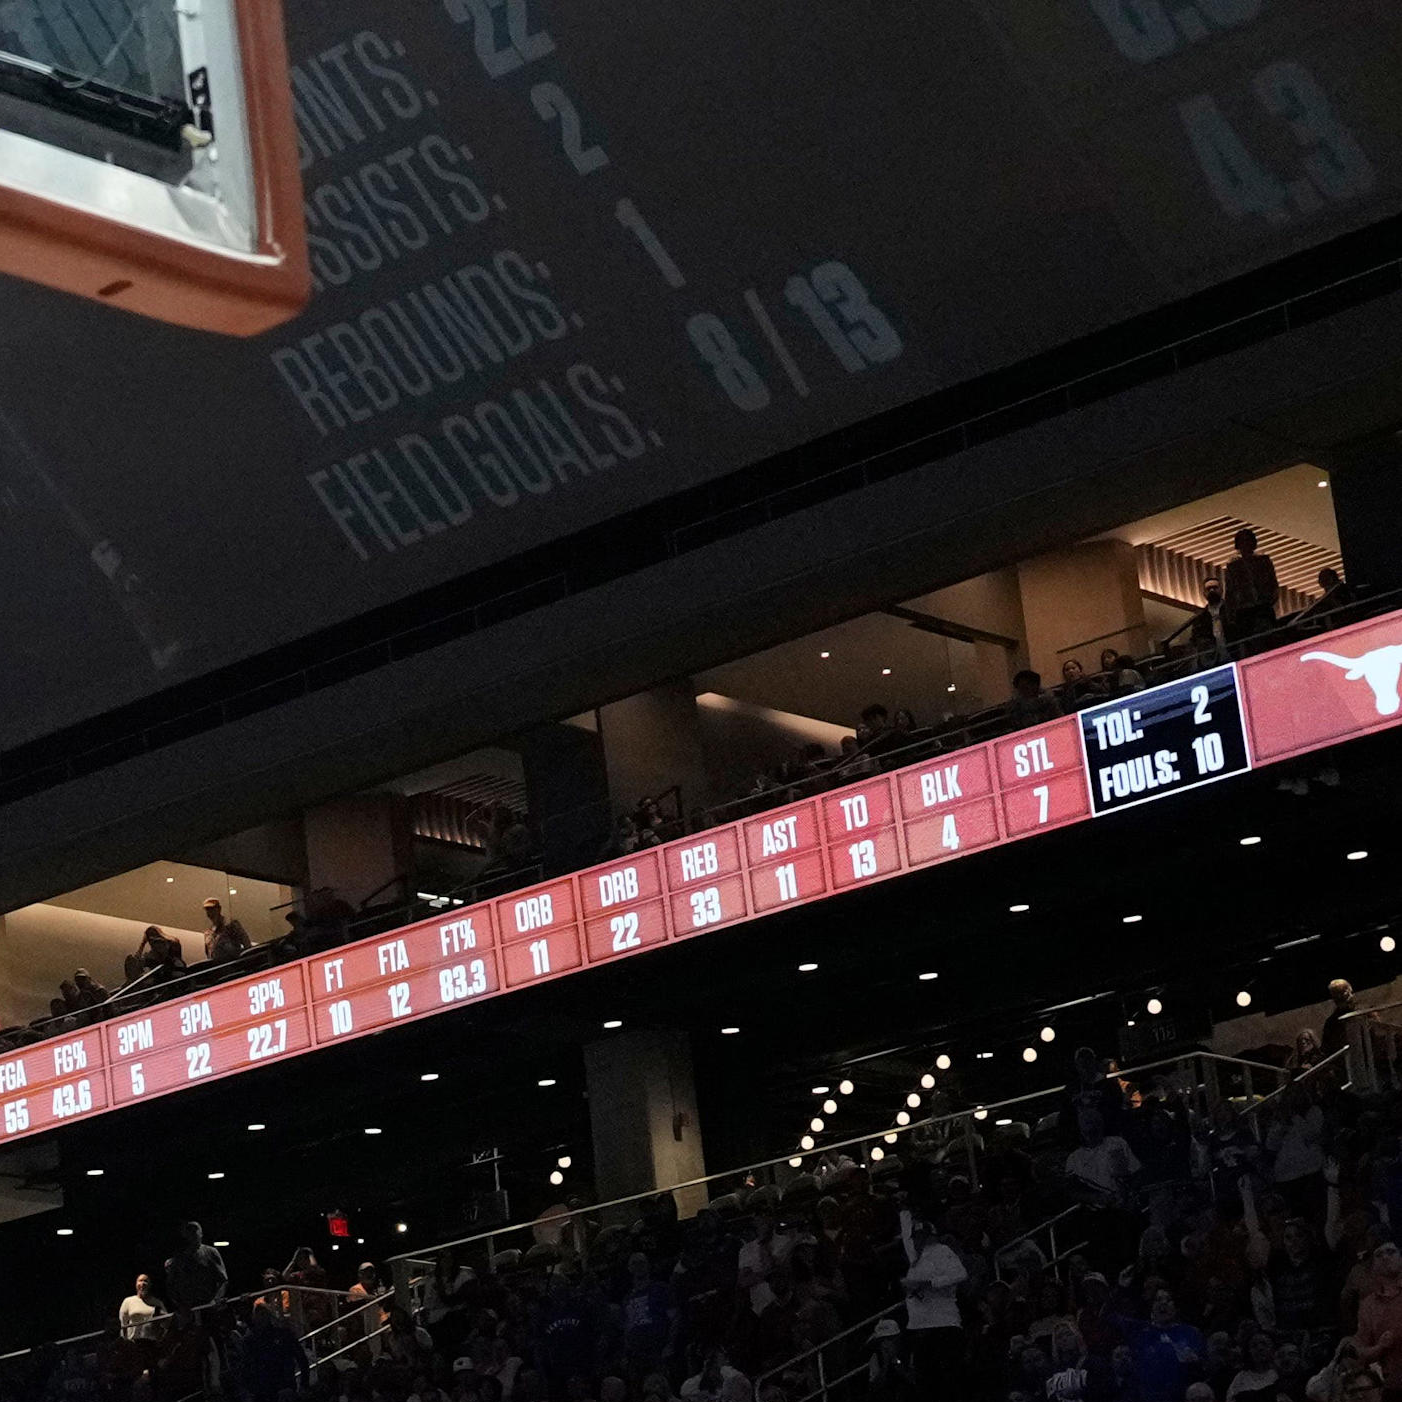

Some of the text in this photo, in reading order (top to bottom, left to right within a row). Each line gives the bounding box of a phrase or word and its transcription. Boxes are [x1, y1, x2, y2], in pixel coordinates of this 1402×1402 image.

[290, 31, 439, 170] INTS:
[309, 82, 609, 293] SSISTS: 2
[271, 198, 686, 436] REBOUNDS: 1
[307, 434, 472, 562] FIELD
[442, 364, 665, 508] GOALS:
[1092, 686, 1212, 751] TOL: 2
[1099, 733, 1224, 802] FOULS: 10
[516, 738, 1053, 932] ORB DRB REB AST TO BLK STL
[530, 786, 1049, 975] 11 22 33 11 13 4 7
[325, 919, 475, 991] FT FTA FT%
[118, 979, 284, 1055] 3PM 3PA 3P%
[330, 961, 486, 1035] 10 12 83.3
[54, 1041, 86, 1076] FG%
[130, 1019, 288, 1094] 5 22 22.7
[5, 1100, 30, 1132] 55
[53, 1081, 91, 1118] 43.6
